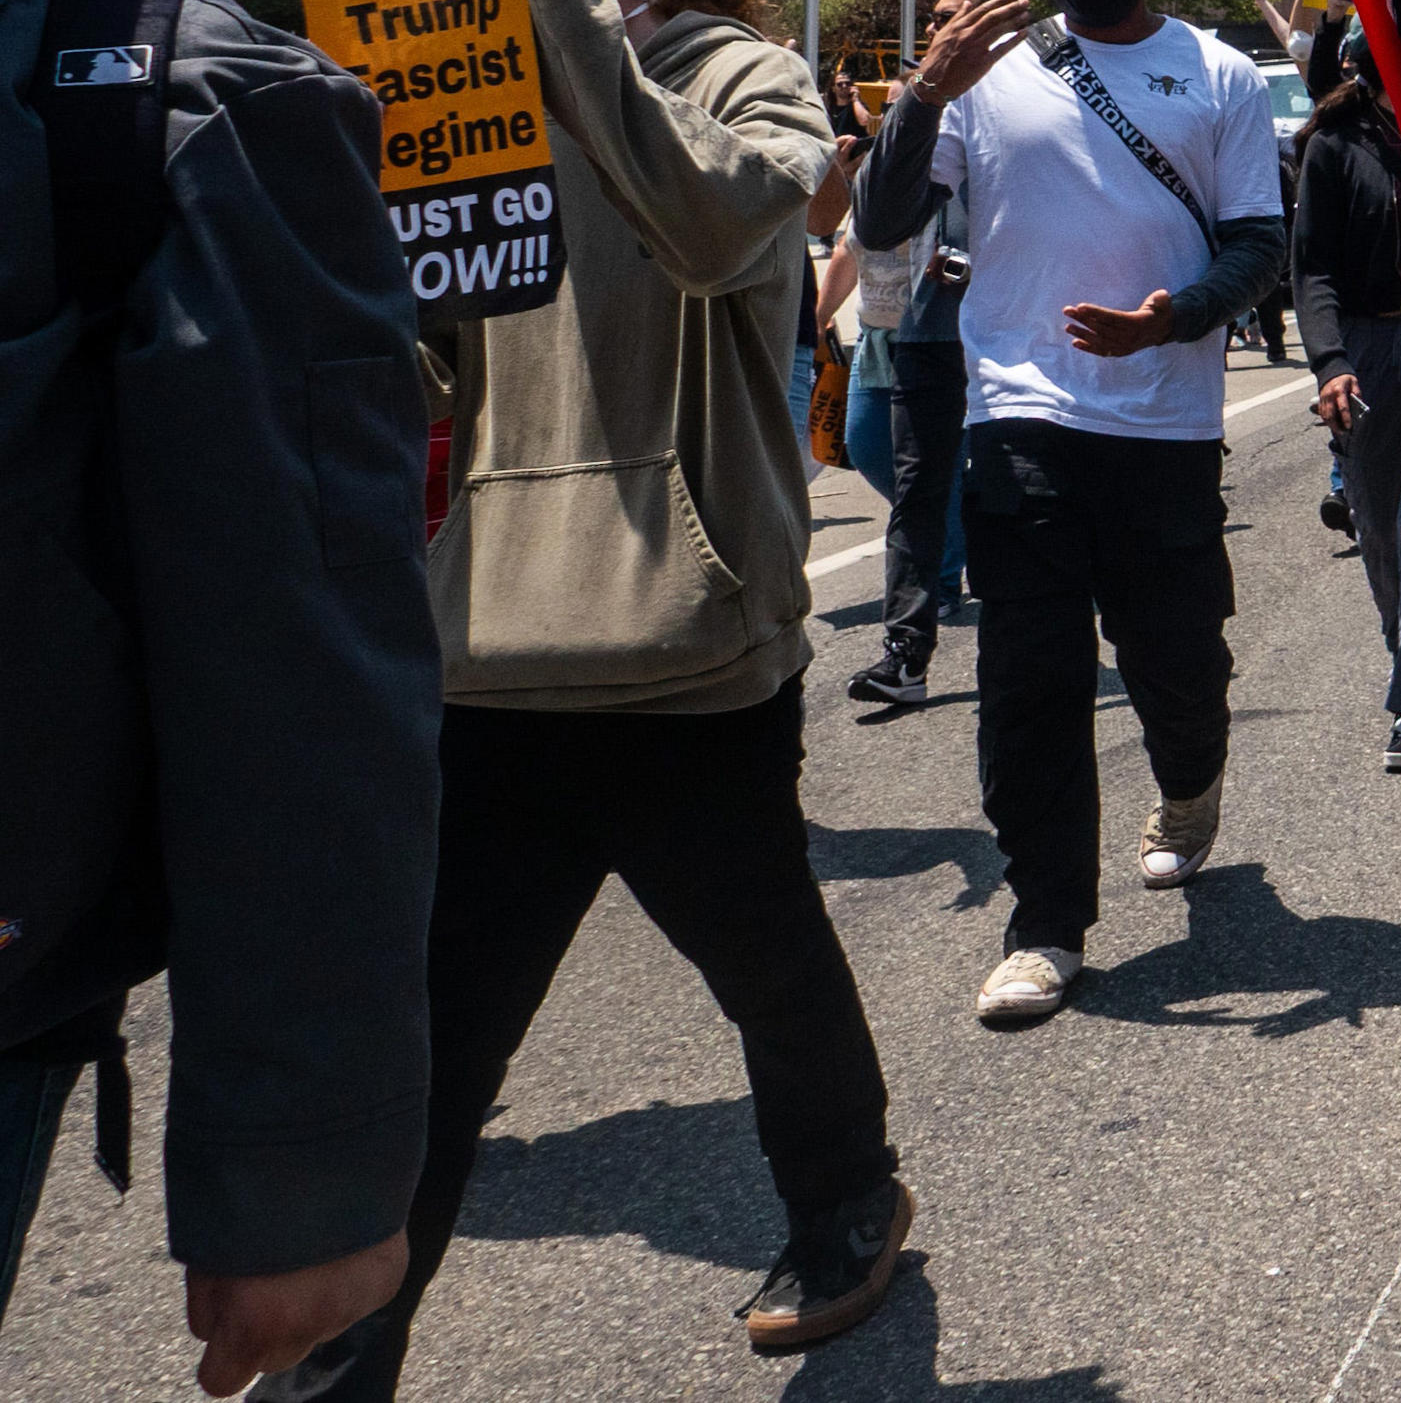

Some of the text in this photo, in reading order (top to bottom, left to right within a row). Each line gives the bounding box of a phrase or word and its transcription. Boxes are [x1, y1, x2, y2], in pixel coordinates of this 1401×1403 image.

[381, 109, 537, 177] egime
[388, 182, 554, 243] UST GO
[404, 234, 550, 301] OW!!!
